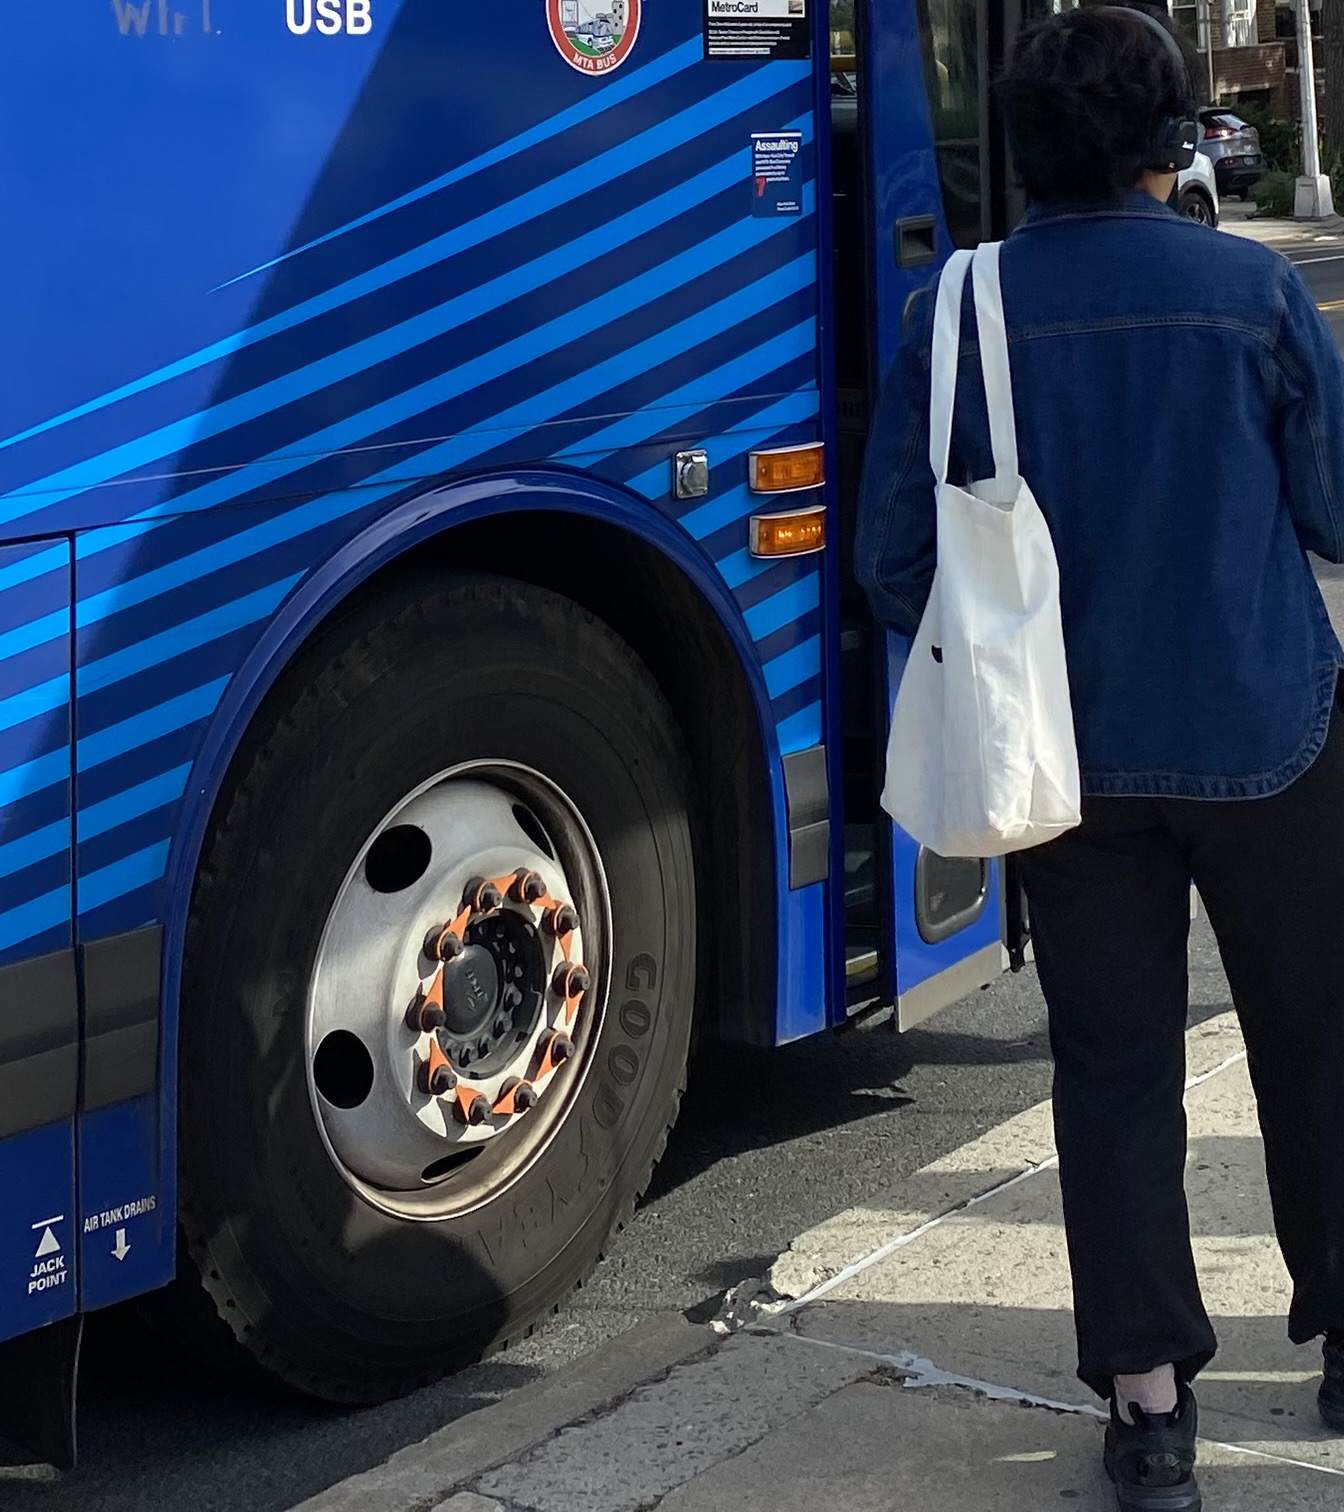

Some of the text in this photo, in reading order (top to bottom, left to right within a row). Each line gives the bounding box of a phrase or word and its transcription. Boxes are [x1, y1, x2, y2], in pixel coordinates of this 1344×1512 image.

[711, 0, 759, 14] MetroCard
[572, 52, 617, 70] MTA BUS
[755, 139, 799, 153] Assaulting
[83, 1194, 156, 1233] AIR TANK DRAINS
[29, 1255, 65, 1278] JACK
[27, 1269, 68, 1295] POINT
